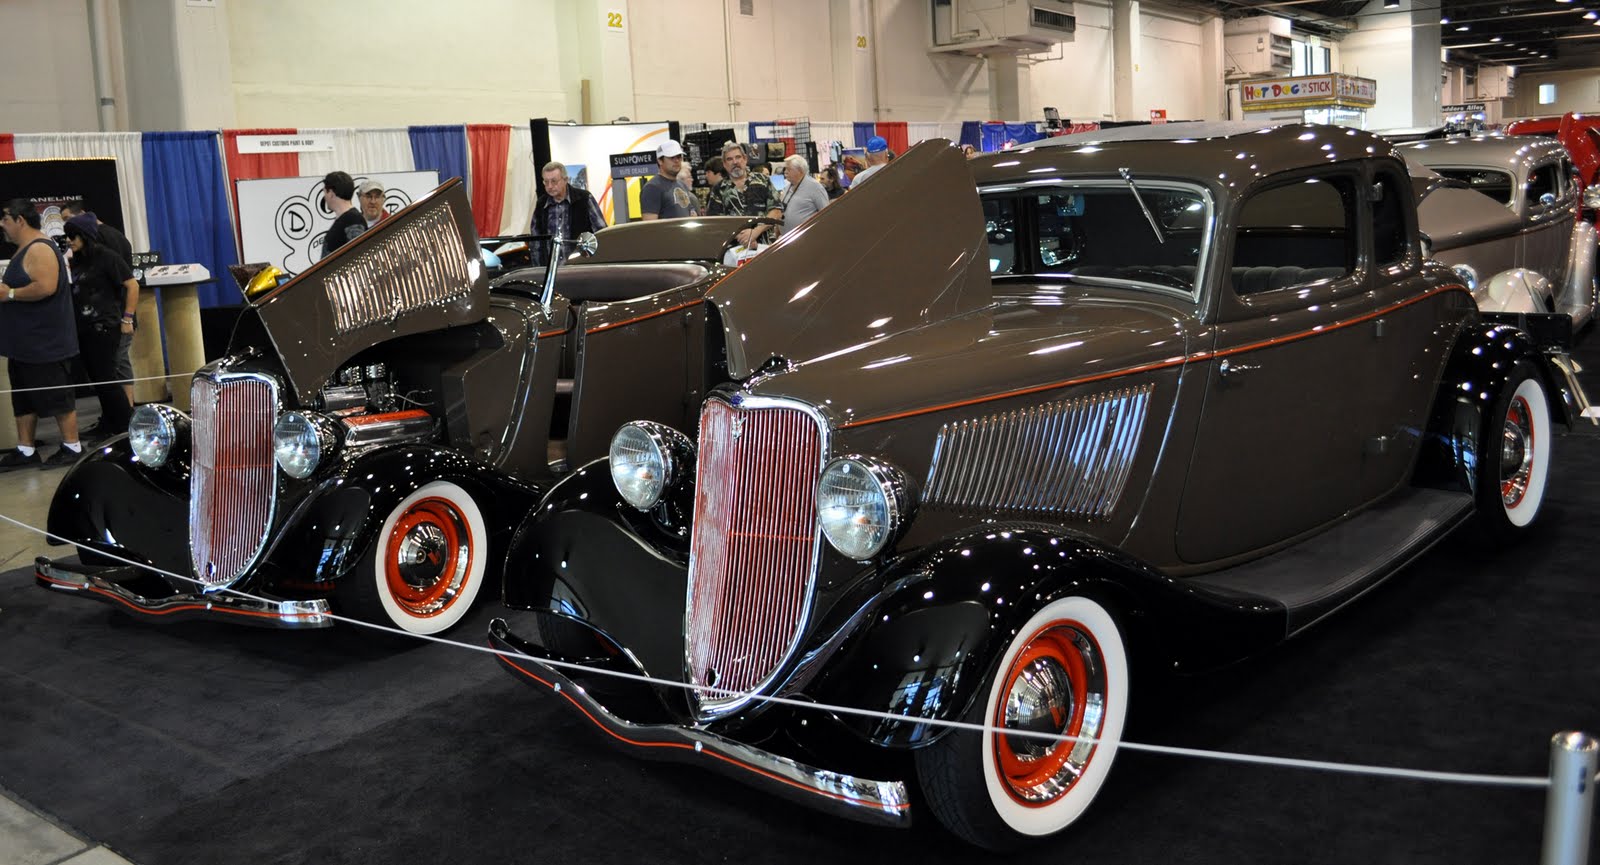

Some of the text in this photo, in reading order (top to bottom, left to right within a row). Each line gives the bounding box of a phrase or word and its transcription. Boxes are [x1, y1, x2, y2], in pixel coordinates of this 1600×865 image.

[607, 12, 623, 28] 22
[856, 35, 867, 49] 20
[1245, 86, 1269, 100] HOT
[1272, 84, 1299, 97] DOG
[1309, 81, 1331, 93] STICK
[614, 154, 652, 165] SUNPOWER
